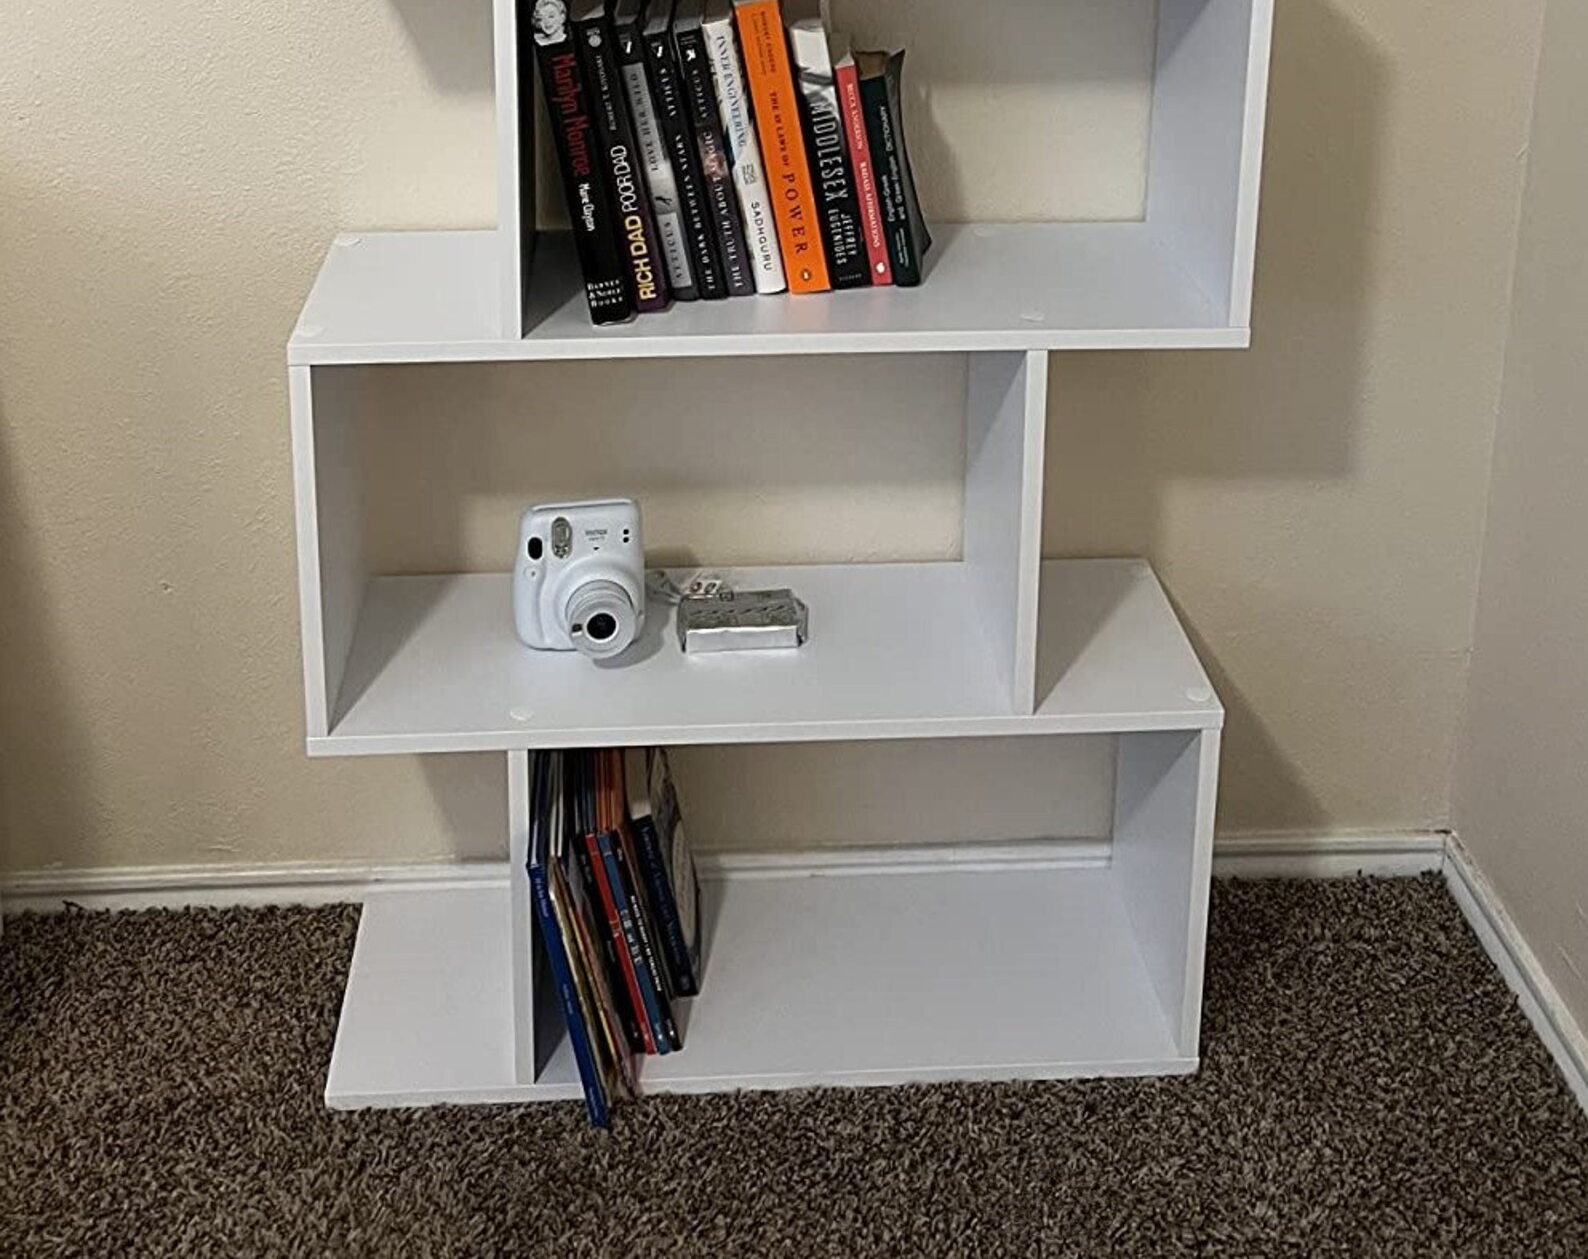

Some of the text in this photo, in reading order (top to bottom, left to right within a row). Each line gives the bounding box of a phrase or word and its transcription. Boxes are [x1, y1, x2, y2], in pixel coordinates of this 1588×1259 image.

[552, 53, 590, 176] Marilyn Monroe
[716, 35, 747, 148] INNER ENGINEERING
[769, 92, 780, 110] THE
[629, 73, 659, 171] LOVE HER WILD
[776, 126, 787, 152] LAWS
[850, 110, 863, 150] ANDERSON
[879, 106, 893, 152] DICTIONARY
[781, 154, 790, 167] OF
[809, 101, 848, 201] MIDDLESEX
[610, 145, 657, 300] RICH DAD POOR DAD
[684, 175, 702, 229] BETWEEN
[702, 131, 744, 288] THE TRUTH ABOUT MAGIC
[782, 173, 809, 256] POWER
[865, 192, 880, 248] AFFIRMATIONS
[897, 205, 906, 220] and
[697, 233, 709, 264] DARK
[750, 201, 773, 271] SADHGURU
[827, 208, 847, 265] EUGENIDES
[840, 213, 857, 256] JEFFREY
[589, 296, 623, 308] BOOKS
[704, 269, 715, 290] THE
